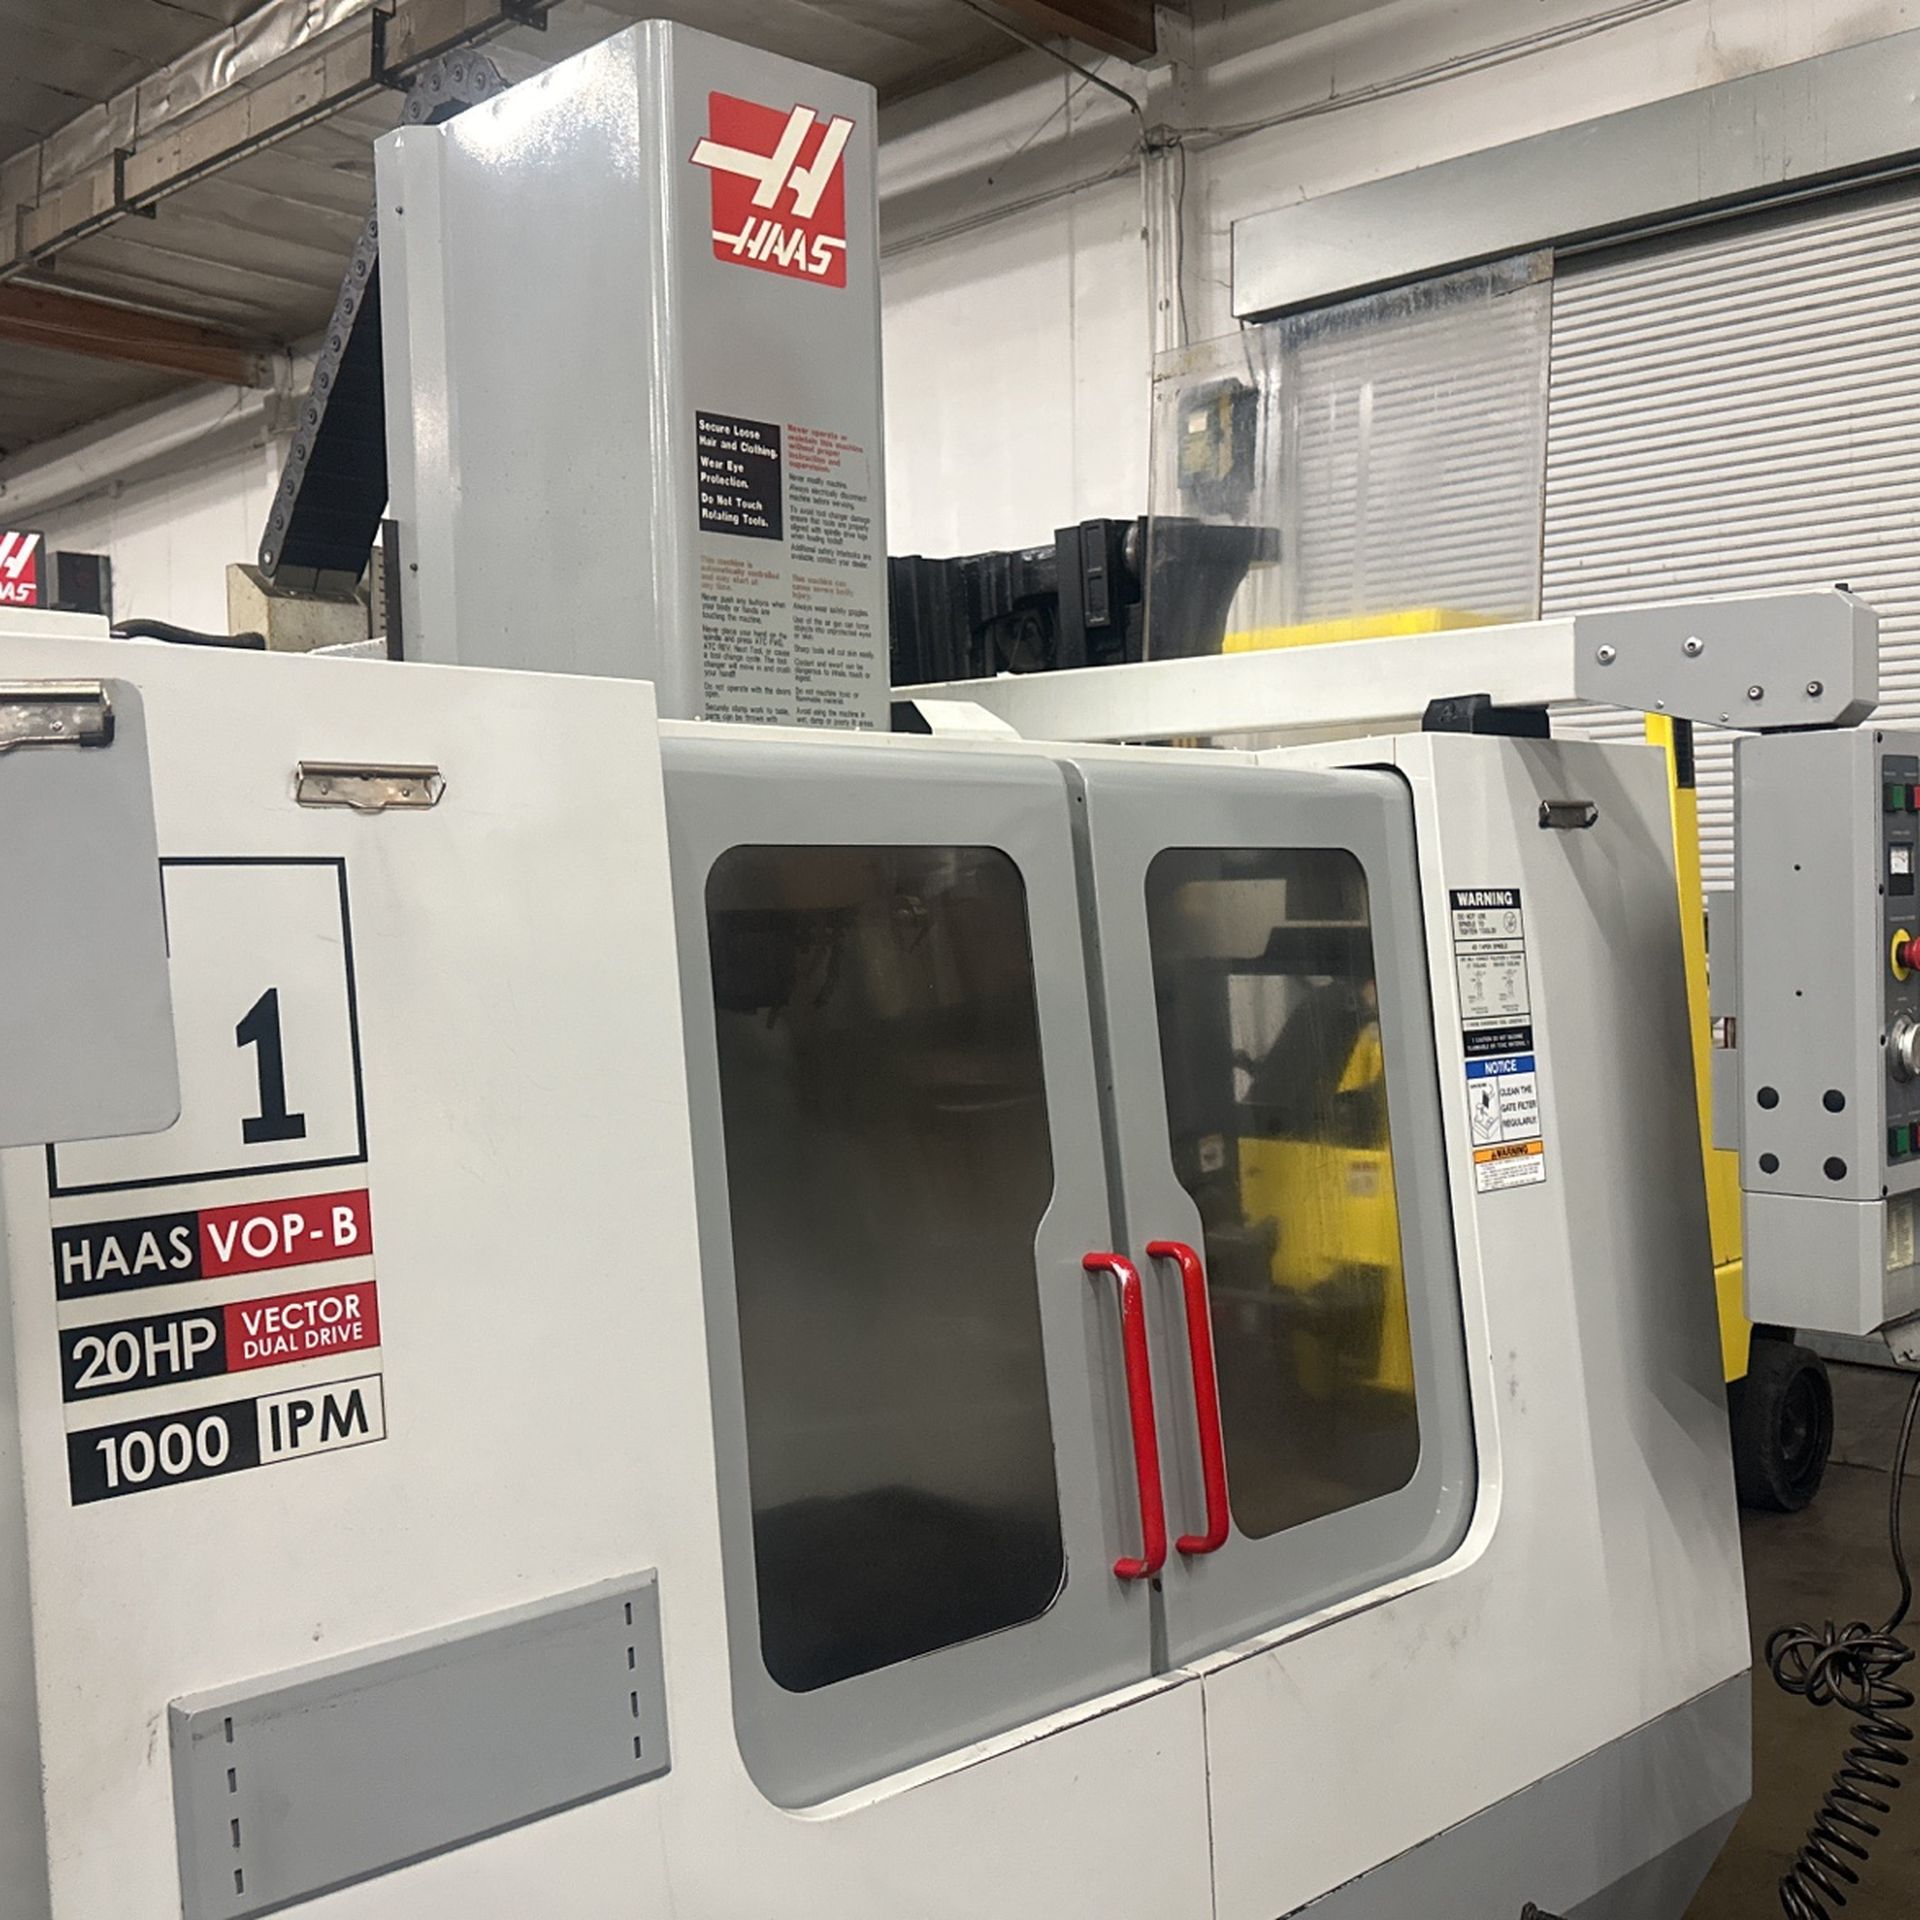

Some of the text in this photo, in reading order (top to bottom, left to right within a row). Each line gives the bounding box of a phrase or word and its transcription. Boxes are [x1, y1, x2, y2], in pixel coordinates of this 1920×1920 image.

[712, 216, 846, 276] HAAS
[699, 419, 760, 439] Secure Loose
[699, 436, 777, 459] Hair and Clothing.
[701, 456, 744, 473] Wear Eye
[701, 472, 749, 488] Protection.
[701, 492, 762, 511] Do Not Touch
[702, 508, 768, 527] Rotating Tools.
[1457, 892, 1512, 906] WARNING
[235, 988, 306, 1144] 1
[1485, 1059, 1517, 1074] NOTICE
[1500, 1085, 1532, 1096] CLEAN THE
[1502, 1100, 1536, 1112] GATE FILTER
[1497, 1145, 1528, 1159] WARNING
[62, 1207, 358, 1285] HAAS VOP-B
[242, 1294, 360, 1336] VECTOR
[244, 1322, 362, 1359] DUAL DRIVE
[72, 1317, 216, 1389] 20HP
[96, 1389, 368, 1488] 1000 IPM
